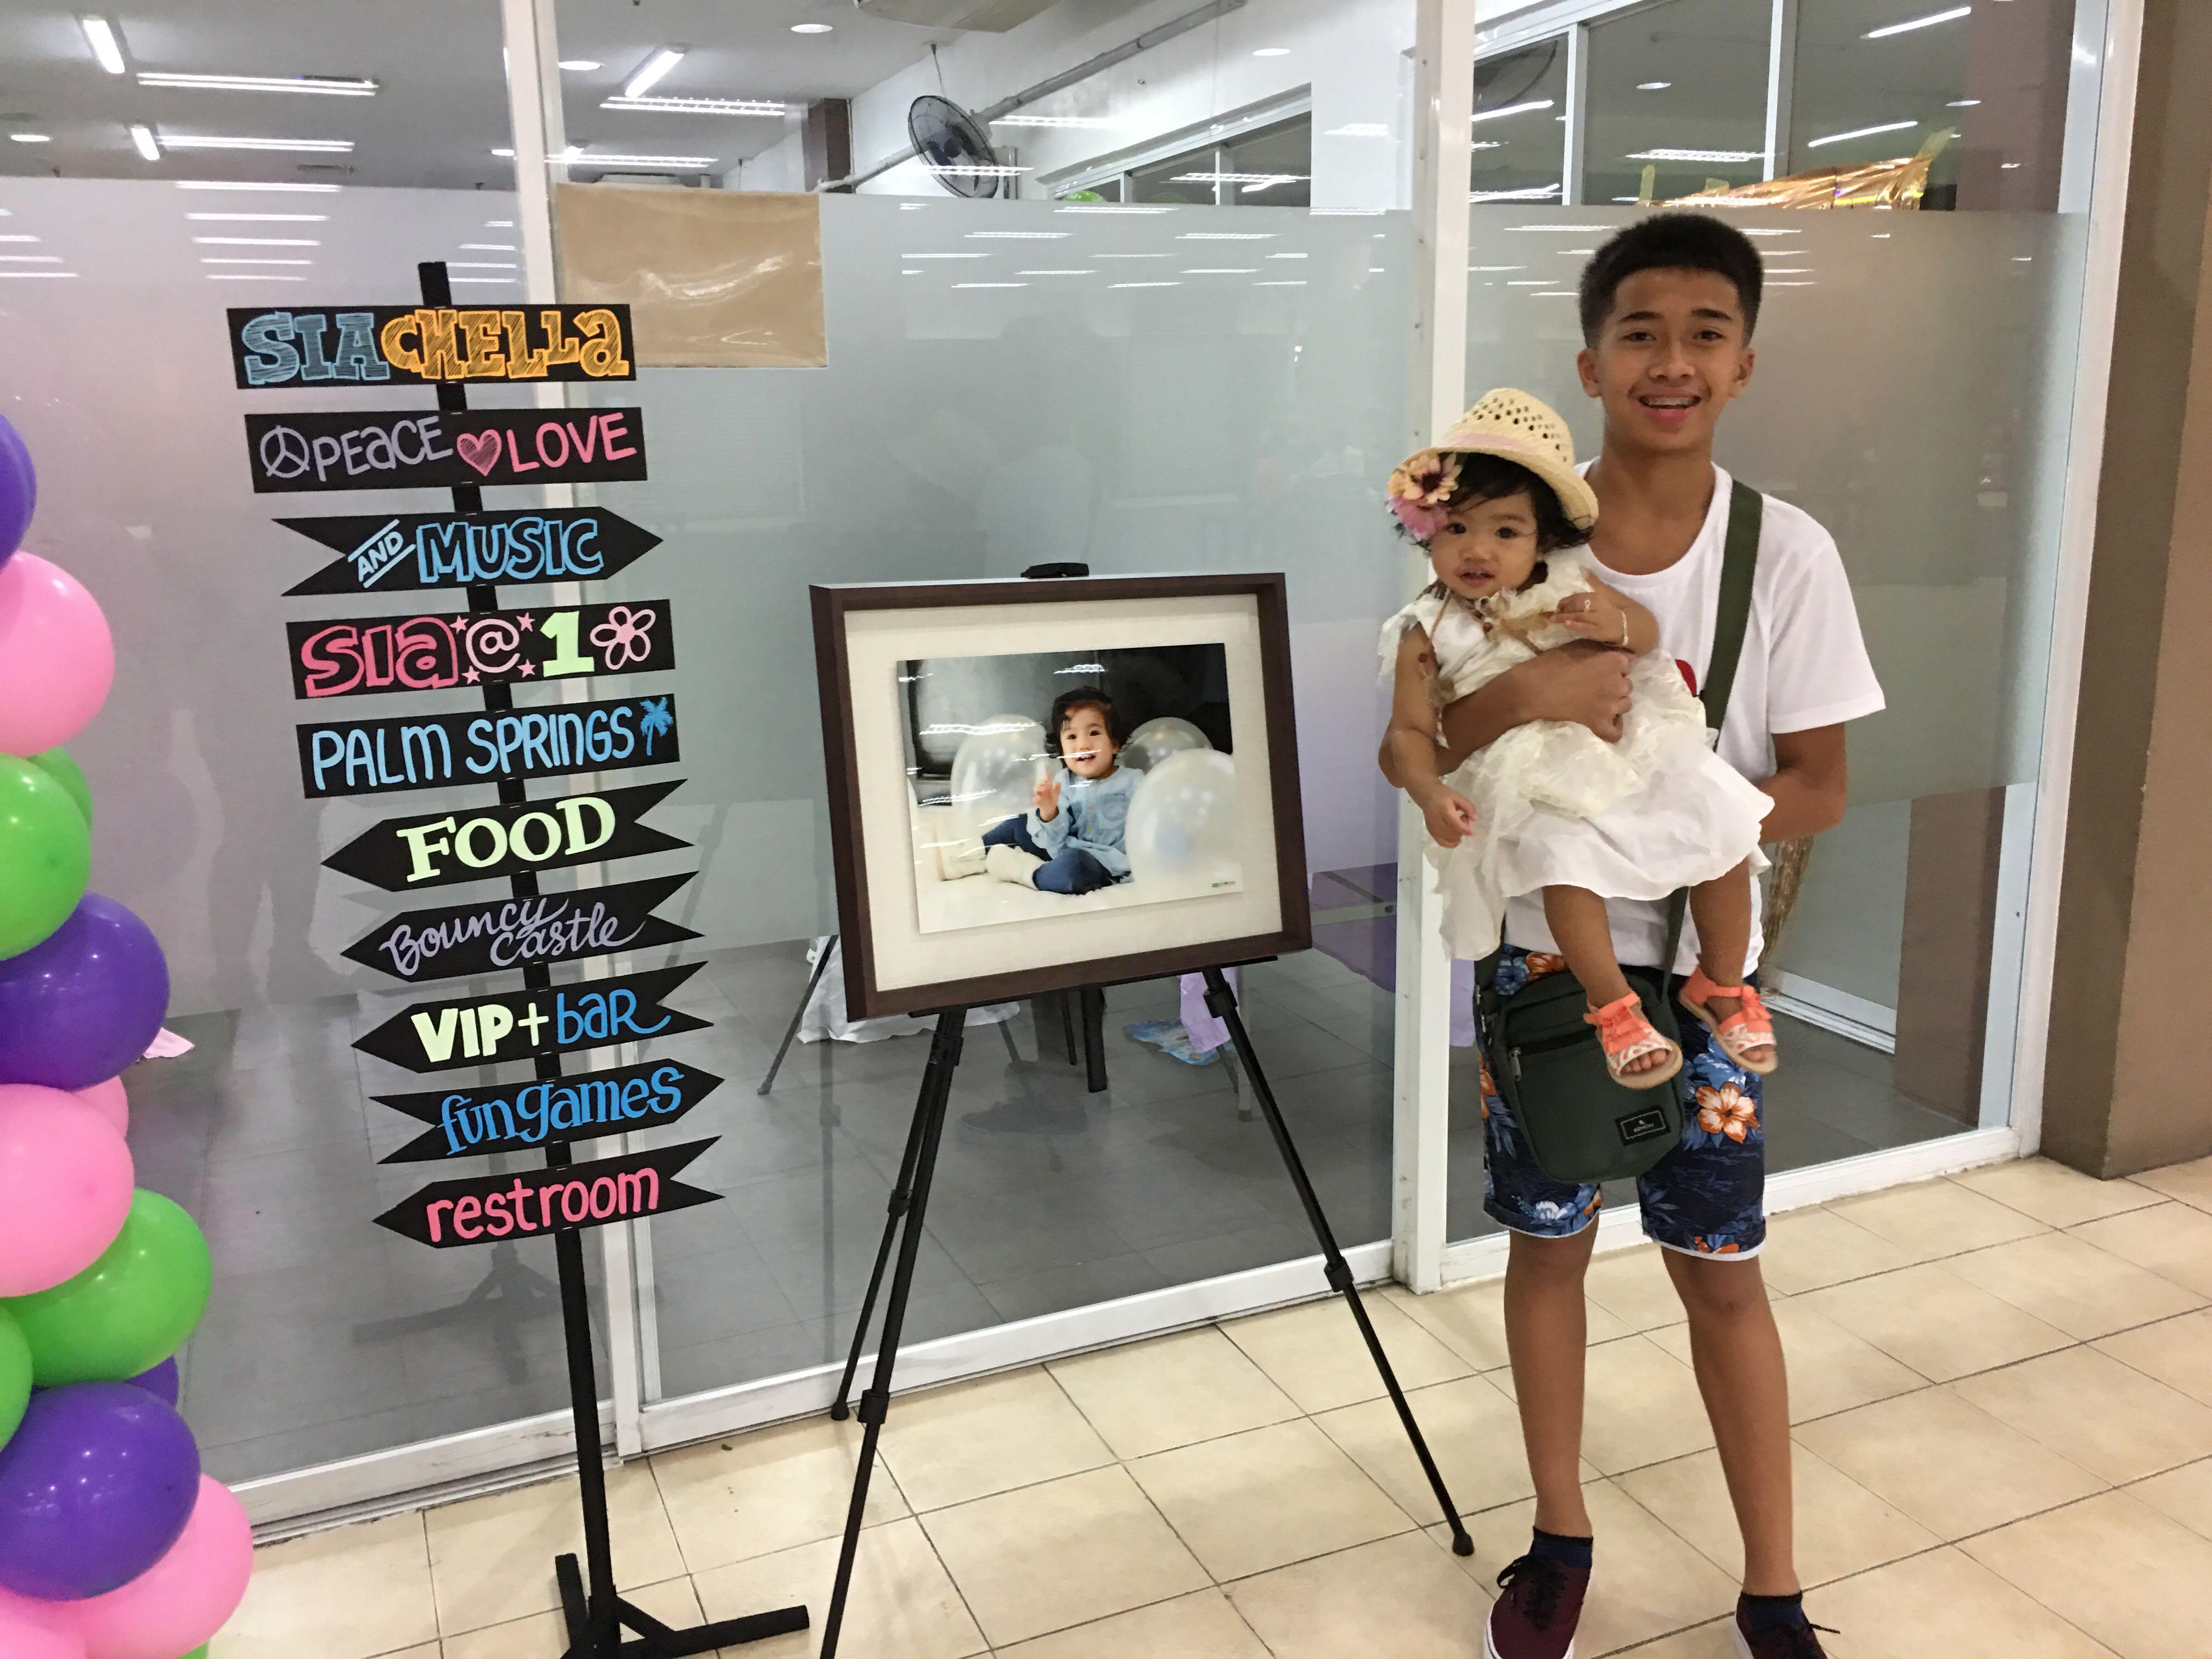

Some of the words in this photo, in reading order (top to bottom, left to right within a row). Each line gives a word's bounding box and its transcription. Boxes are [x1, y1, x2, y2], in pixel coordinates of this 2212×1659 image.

[508, 413, 637, 473] LOVE
[357, 531, 404, 582] AND
[416, 517, 605, 583] MUSIC
[312, 724, 452, 790] PALM
[466, 707, 634, 773] SPRINGS
[397, 797, 616, 882] FOOD
[379, 898, 568, 975] Bouncy
[426, 1167, 658, 1242] restroom
